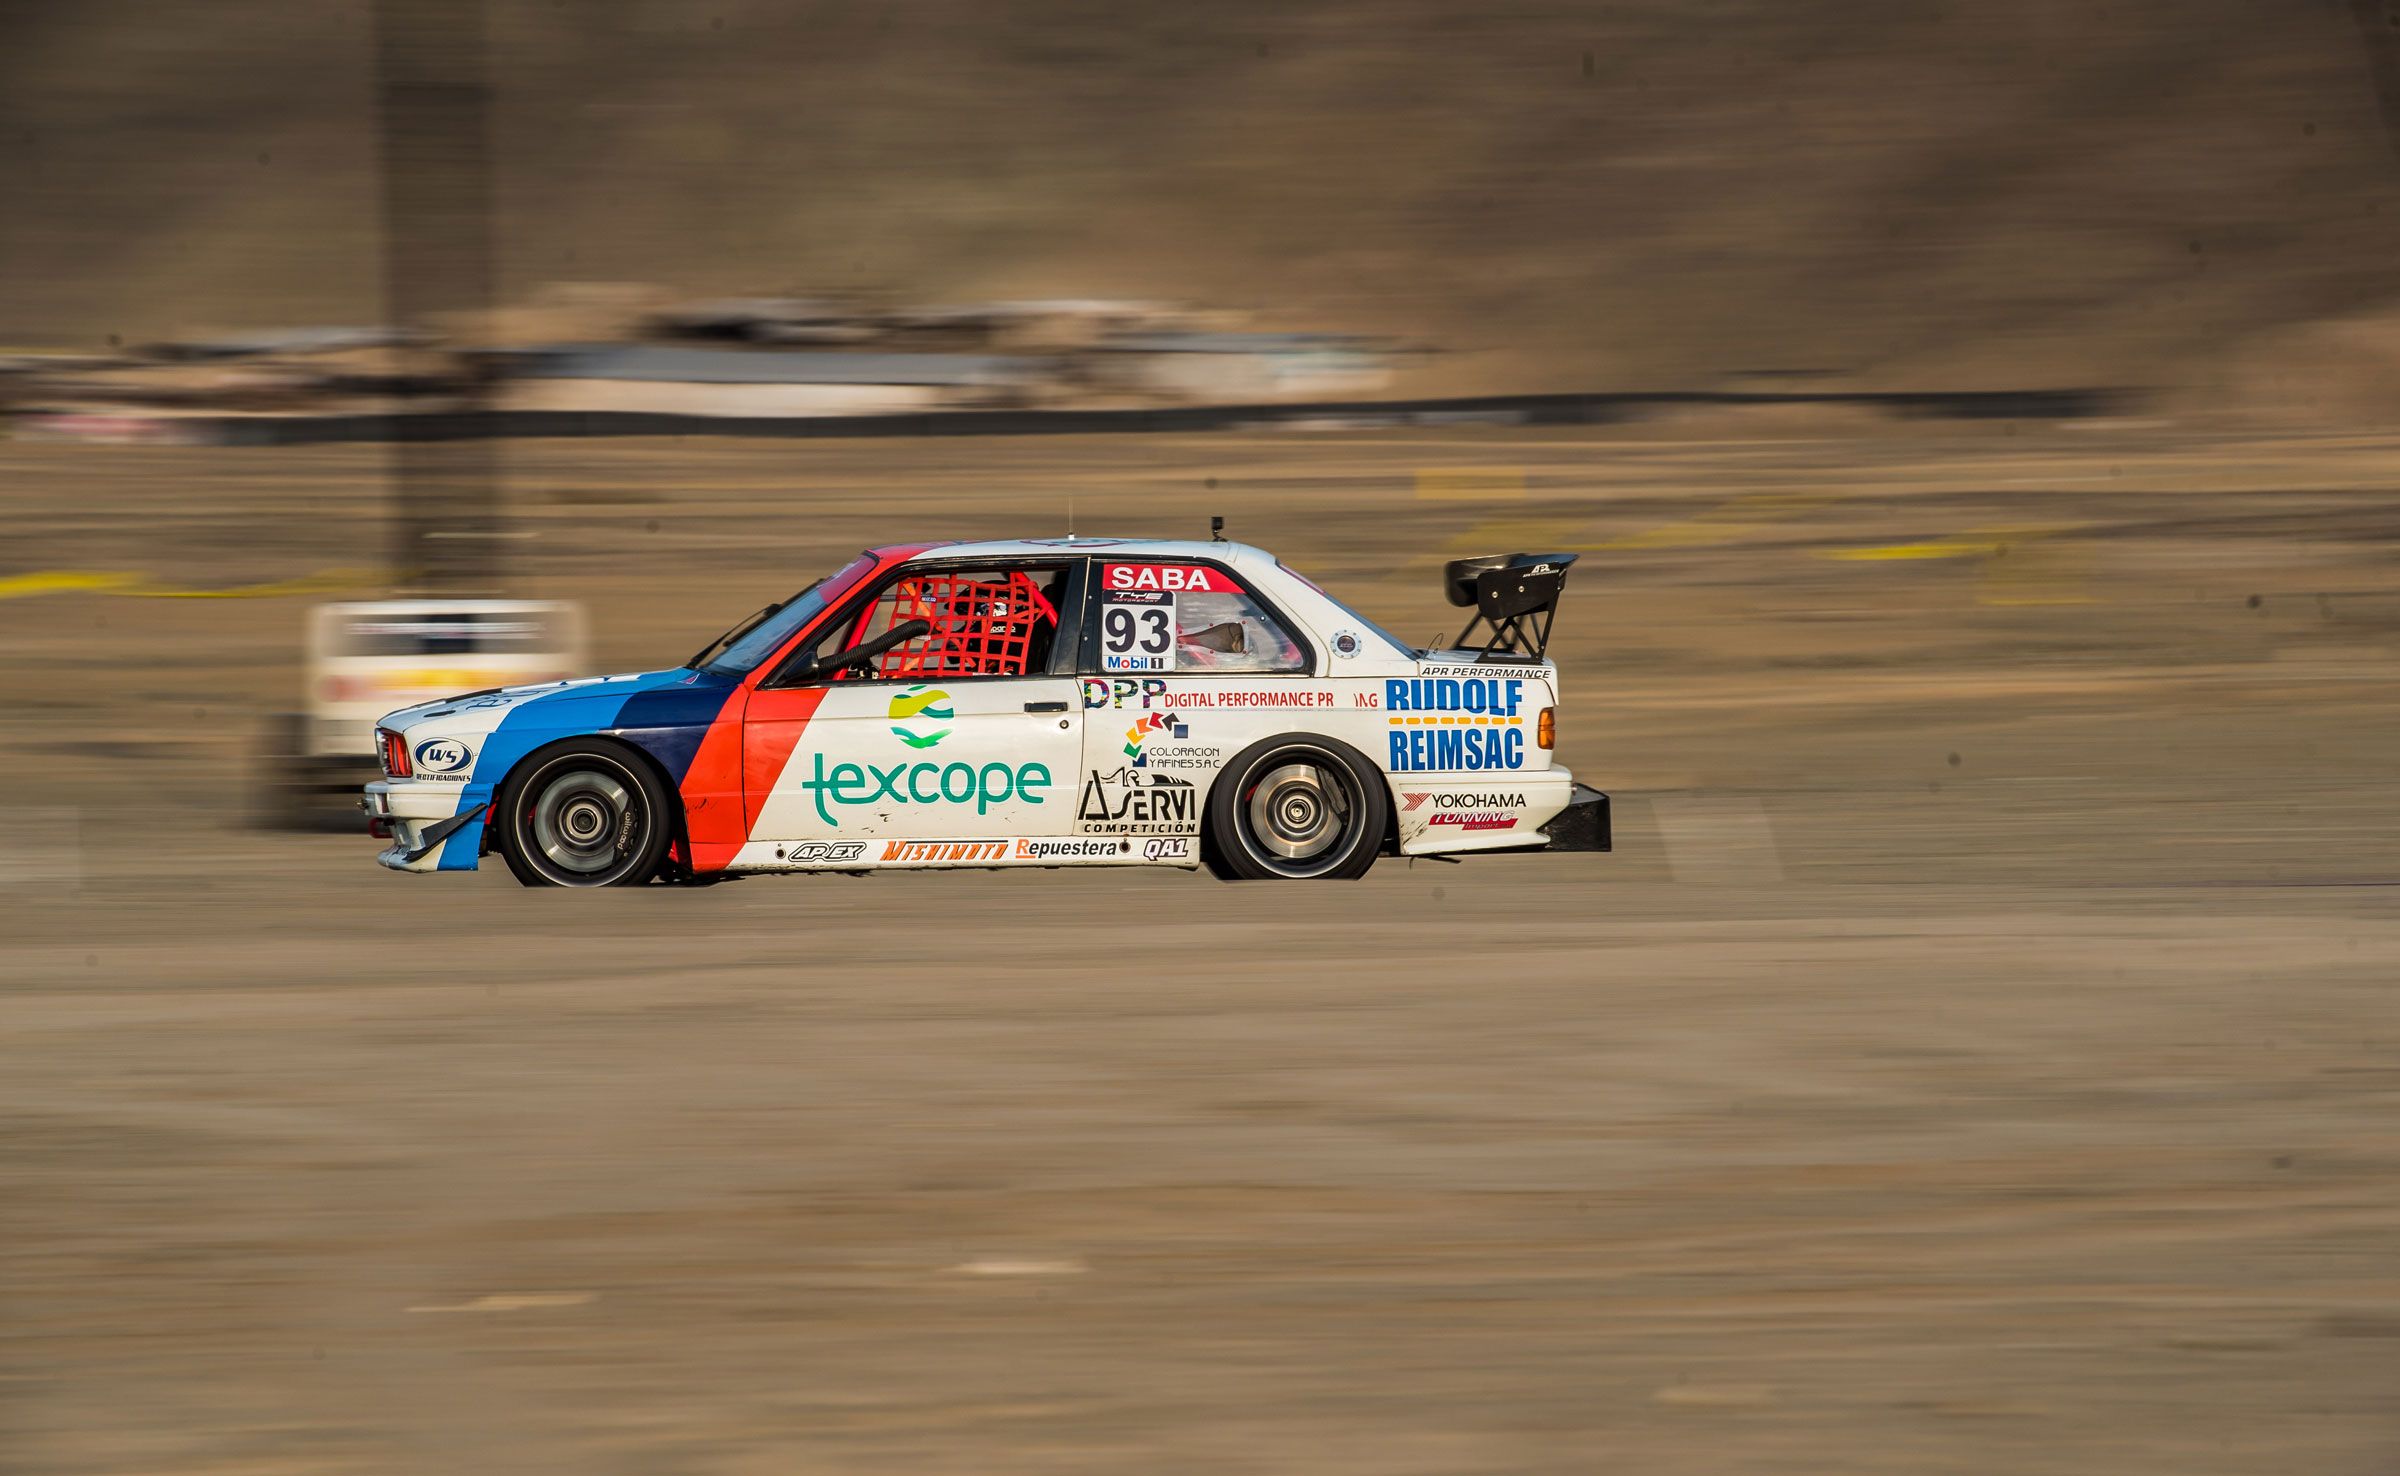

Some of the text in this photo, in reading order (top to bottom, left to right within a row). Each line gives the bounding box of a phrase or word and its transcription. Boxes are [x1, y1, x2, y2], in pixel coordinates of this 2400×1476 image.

[1111, 566, 1211, 591] SABA
[1105, 608, 1171, 654] 93
[1107, 656, 1163, 669] Mobil 1
[1421, 667, 1552, 679] APR PERFORMANCE
[1083, 679, 1167, 709] DPP
[1164, 693, 1215, 708] DIGITAL
[1218, 692, 1314, 707] PERFORMANCE
[1385, 678, 1523, 717] RUDOLF
[1149, 747, 1220, 757] COLORACION
[1388, 727, 1524, 771] REIMSAC
[1158, 759, 1193, 769] AFINES
[801, 752, 1052, 827] texcope
[1077, 770, 1196, 821] ASERVI
[1431, 793, 1527, 808] YOKOHAMA
[1083, 820, 1196, 833] COMPETICIÓN
[1434, 810, 1515, 824] TUNNING
[1015, 838, 1117, 859] Repuestera
[1143, 838, 1189, 861] QA1
